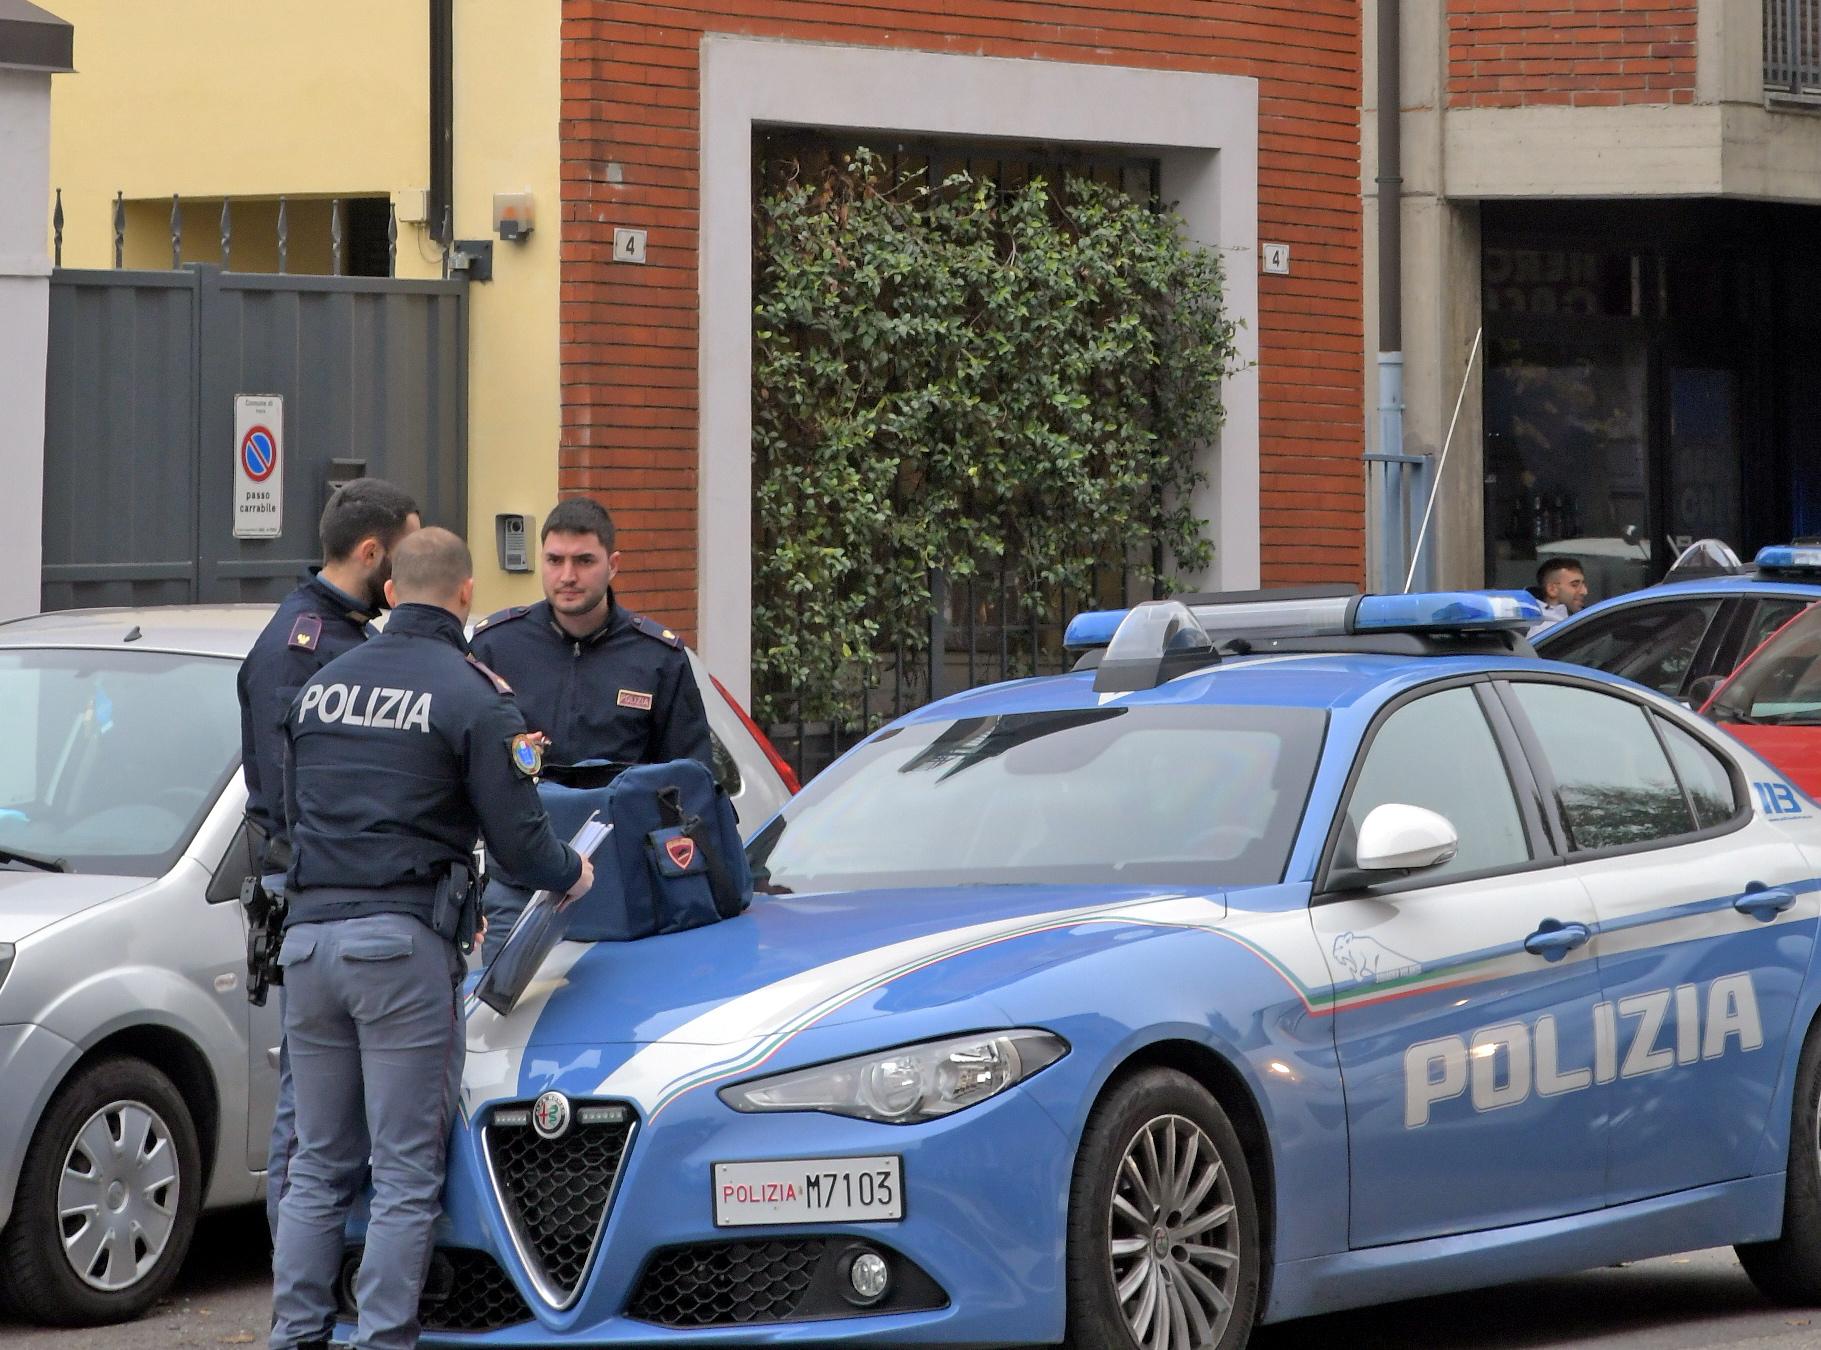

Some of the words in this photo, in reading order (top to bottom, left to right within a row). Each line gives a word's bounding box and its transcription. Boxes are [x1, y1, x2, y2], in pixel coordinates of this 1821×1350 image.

[625, 235, 635, 256] 4
[1272, 249, 1280, 268] 4
[246, 491, 270, 501] passo
[239, 502, 276, 513] carrabile
[298, 684, 432, 733] POLIZIA
[1404, 972, 1764, 1129] POLIZIA
[723, 1183, 796, 1204] POLIZIA
[805, 1170, 893, 1209] M7103
